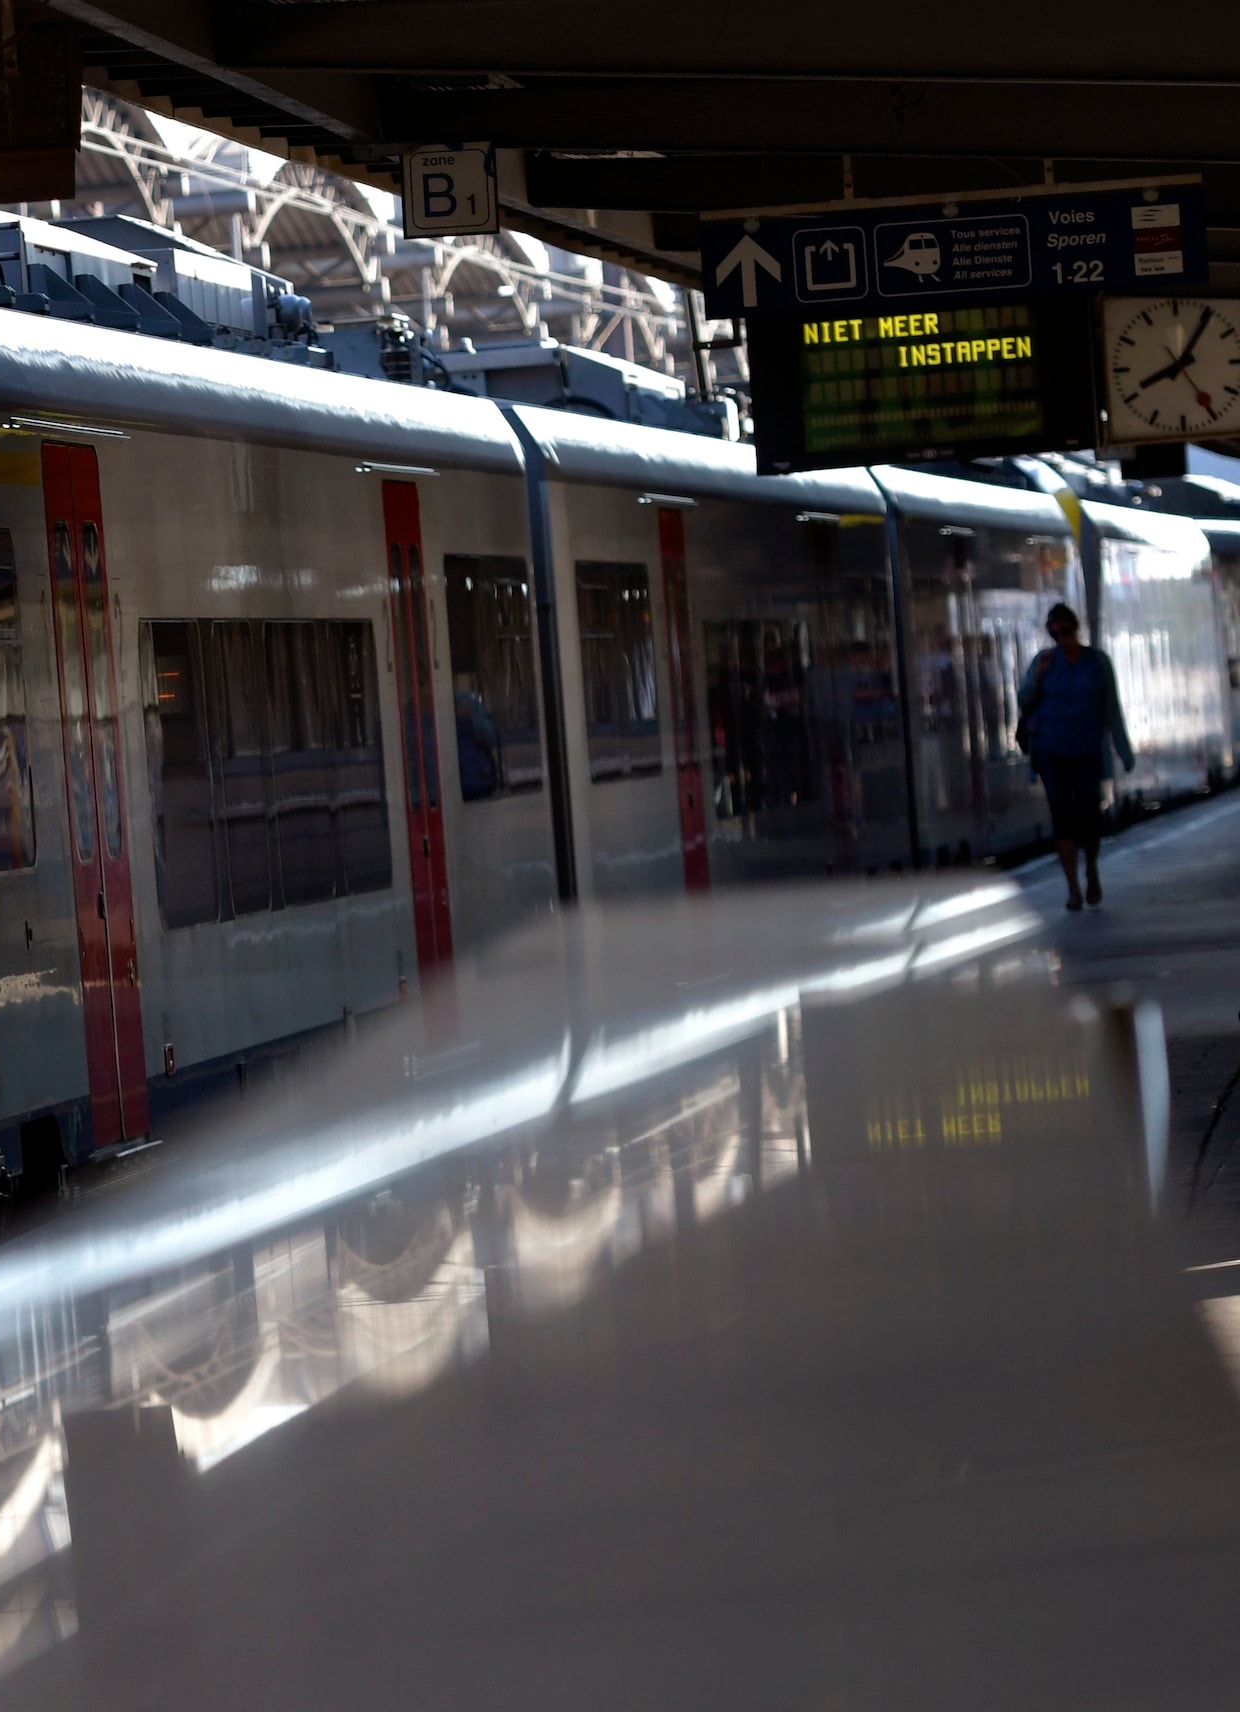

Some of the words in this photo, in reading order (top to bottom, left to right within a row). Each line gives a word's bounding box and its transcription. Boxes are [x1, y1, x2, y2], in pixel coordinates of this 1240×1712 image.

[422, 155, 455, 167] zone
[423, 173, 457, 218] B
[466, 193, 477, 215] 1
[1048, 210, 1096, 225] Voies
[950, 229, 976, 239] Tous
[978, 227, 1022, 237] services
[951, 243, 972, 253] Alle
[974, 241, 1018, 251] diensten
[1046, 232, 1107, 251] Sporen
[952, 257, 972, 267] Alle
[974, 254, 1013, 265] Dienste
[953, 270, 968, 280] All
[969, 268, 1012, 279] services
[1051, 259, 1106, 286] 1-22
[803, 318, 863, 345] NIET
[877, 312, 939, 340] MEER
[897, 335, 1032, 368] INSTAPPEN
